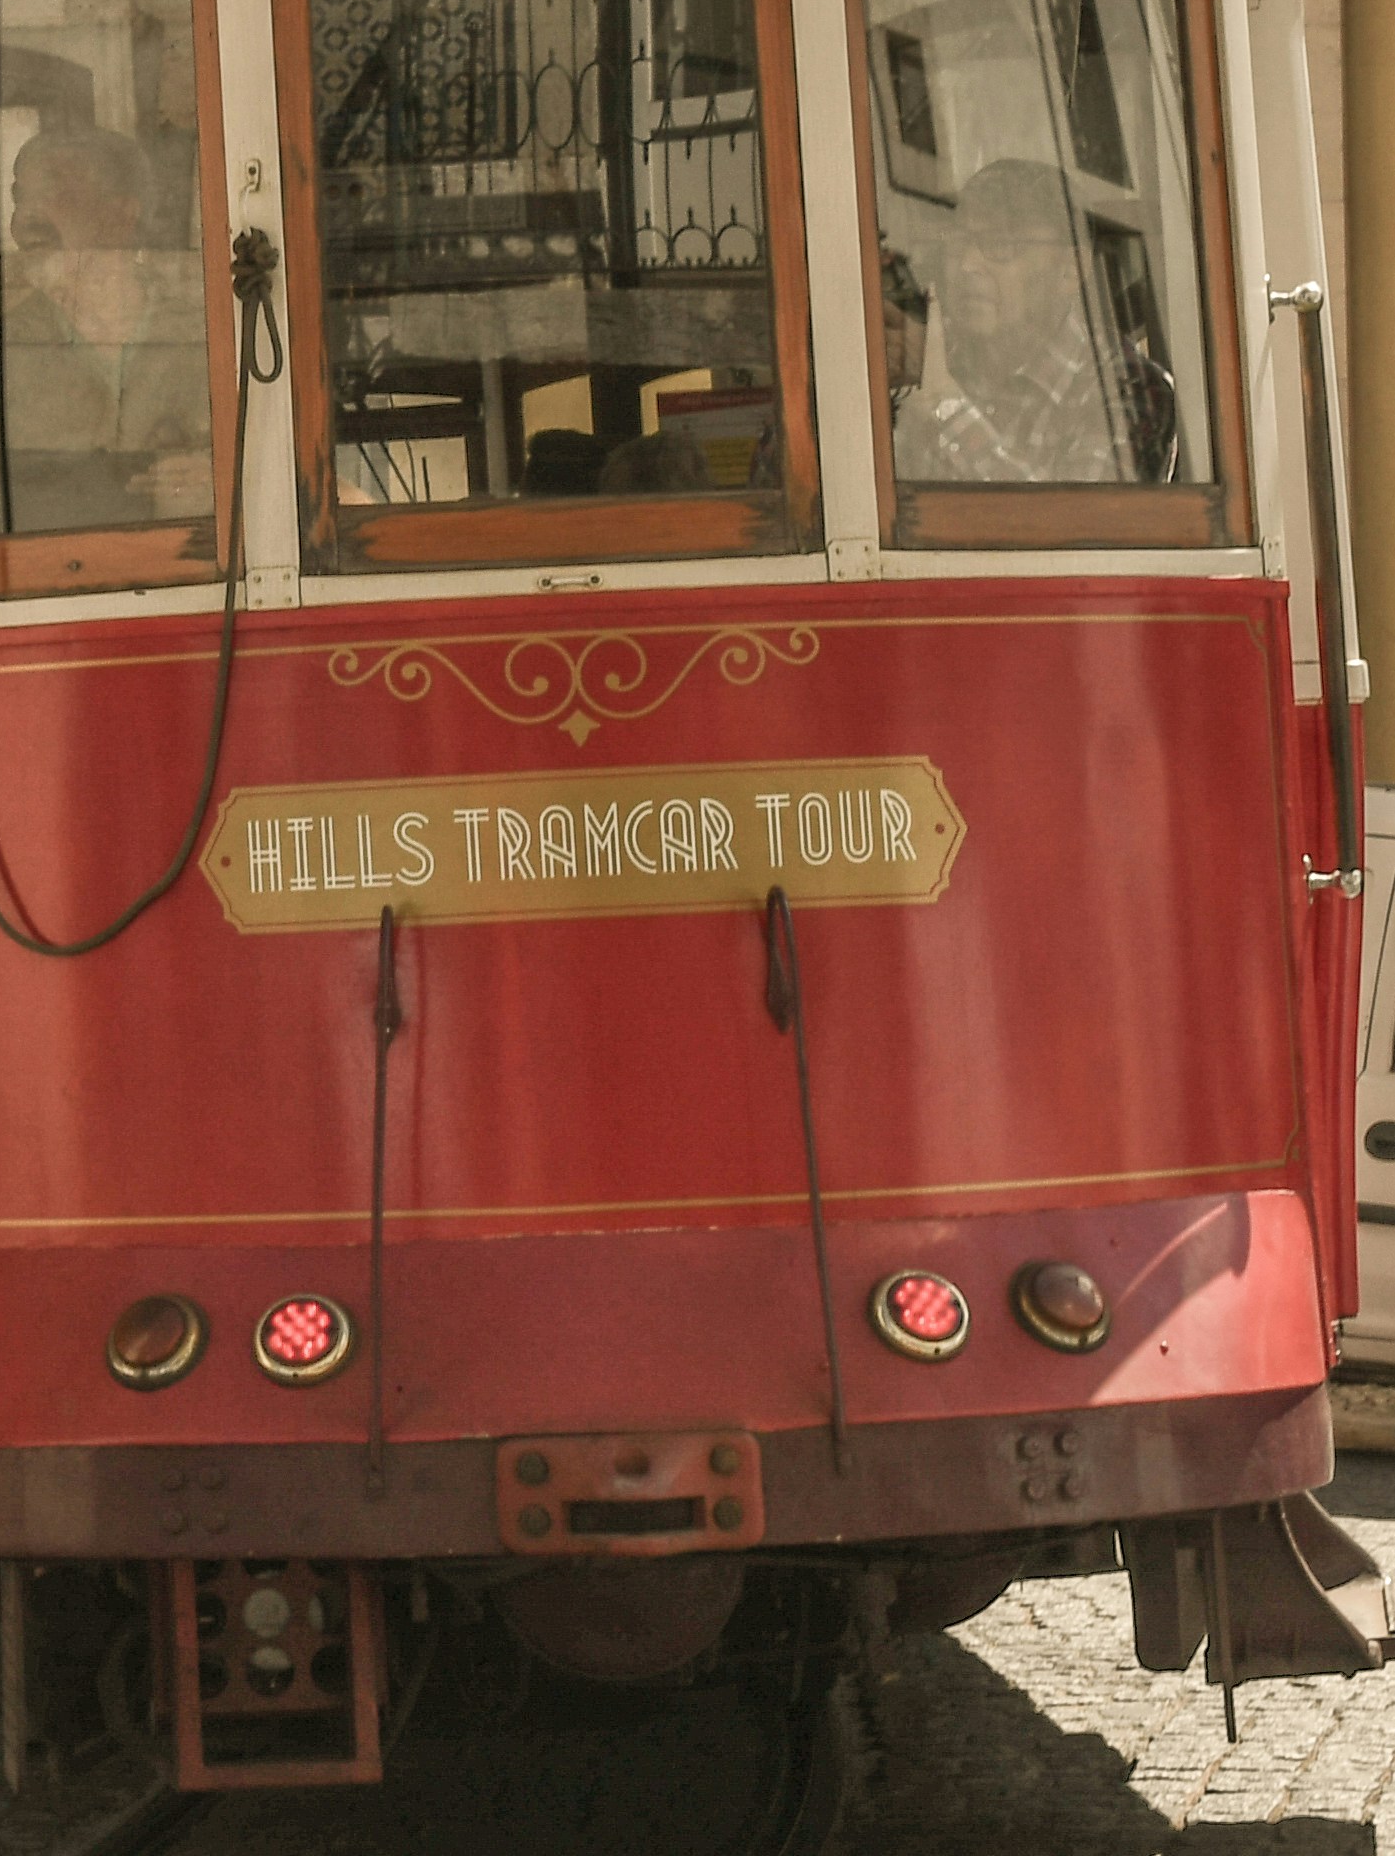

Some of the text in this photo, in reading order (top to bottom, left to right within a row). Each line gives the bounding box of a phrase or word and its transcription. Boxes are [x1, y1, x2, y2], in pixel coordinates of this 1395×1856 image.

[247, 788, 917, 893] HILLS TRAMCAR TOUR
